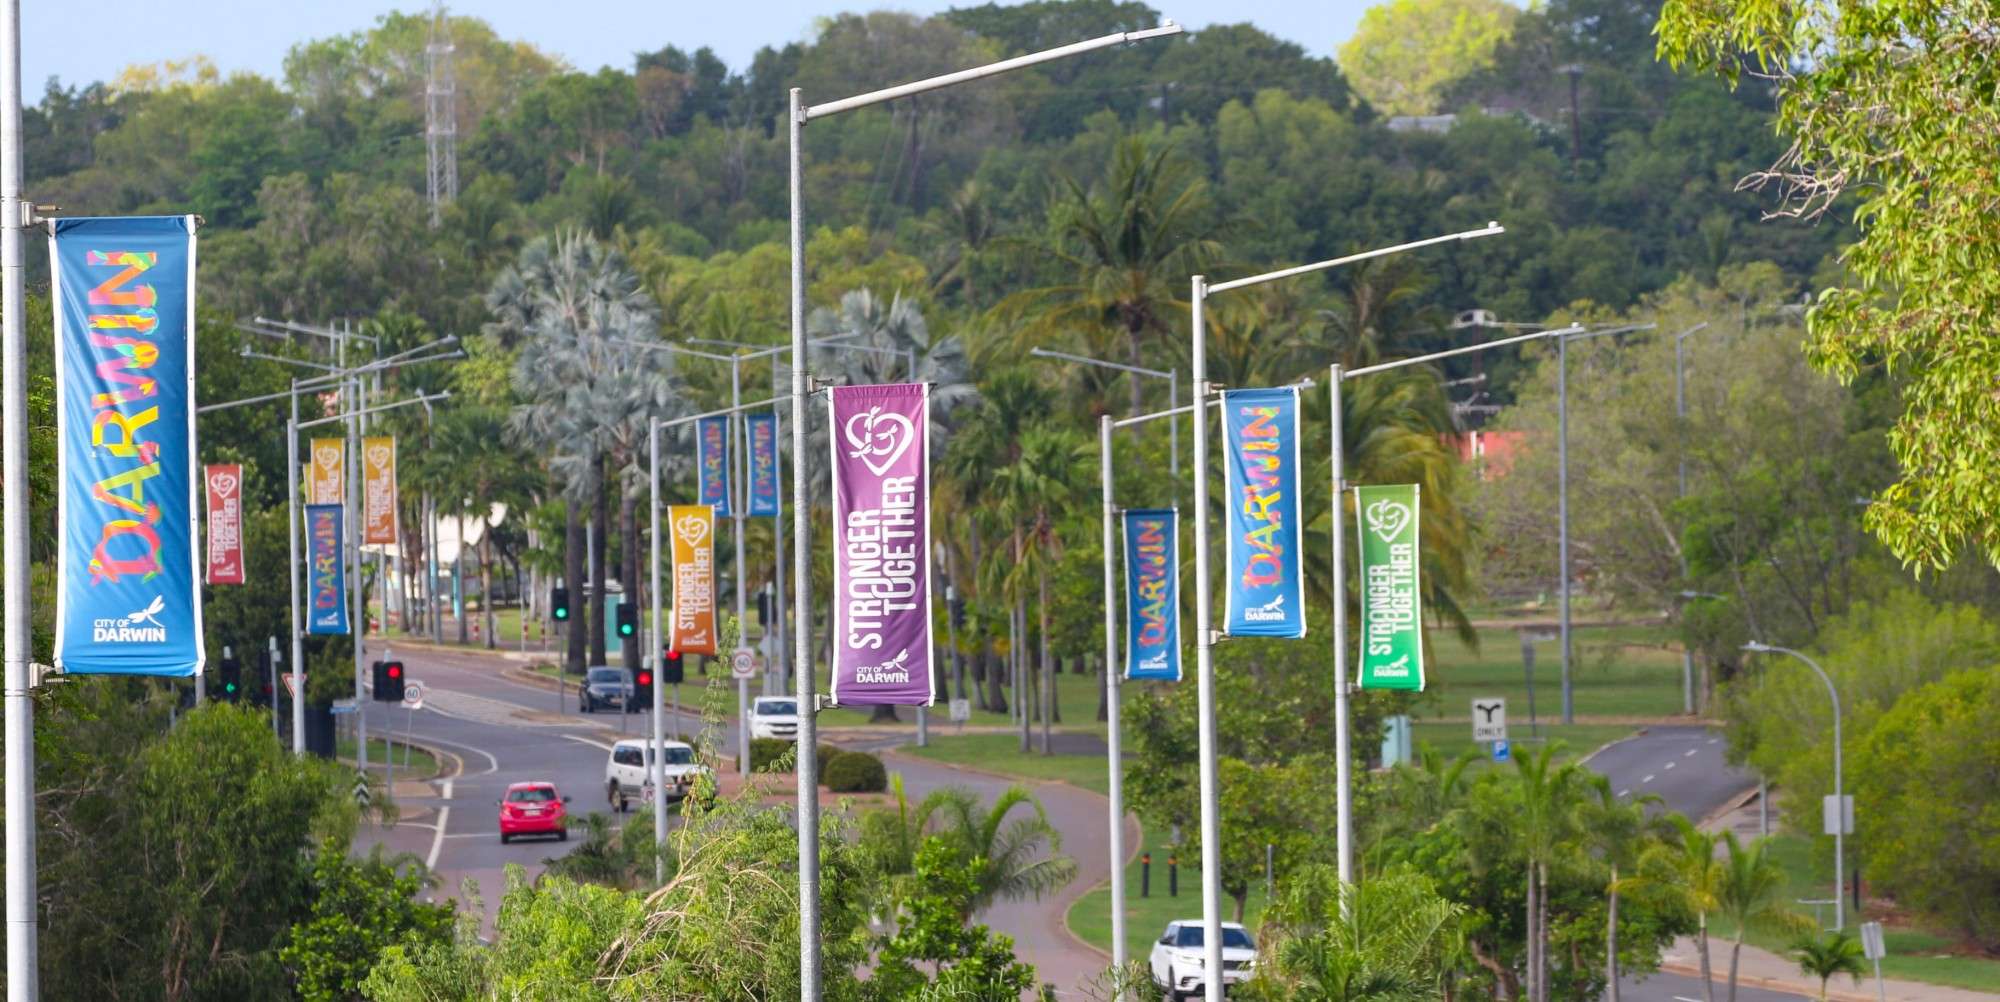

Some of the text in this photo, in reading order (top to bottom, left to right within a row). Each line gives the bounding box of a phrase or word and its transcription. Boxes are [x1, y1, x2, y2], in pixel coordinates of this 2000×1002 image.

[87, 249, 163, 585] DARWIN
[1240, 406, 1283, 589] DARWIN
[314, 512, 338, 609] DARWIN
[694, 547, 711, 614] TOGETHER
[848, 509, 882, 650] STRONGER
[882, 476, 916, 616] TOGETHER
[1137, 520, 1167, 650] DARWIN
[1390, 543, 1414, 633] TOGETHER
[94, 618, 130, 628] CITY OF
[94, 627, 166, 642] DARWIN
[678, 562, 695, 630] STRONGER
[1368, 564, 1392, 656] STRONGER
[856, 672, 909, 683] DARWIN
